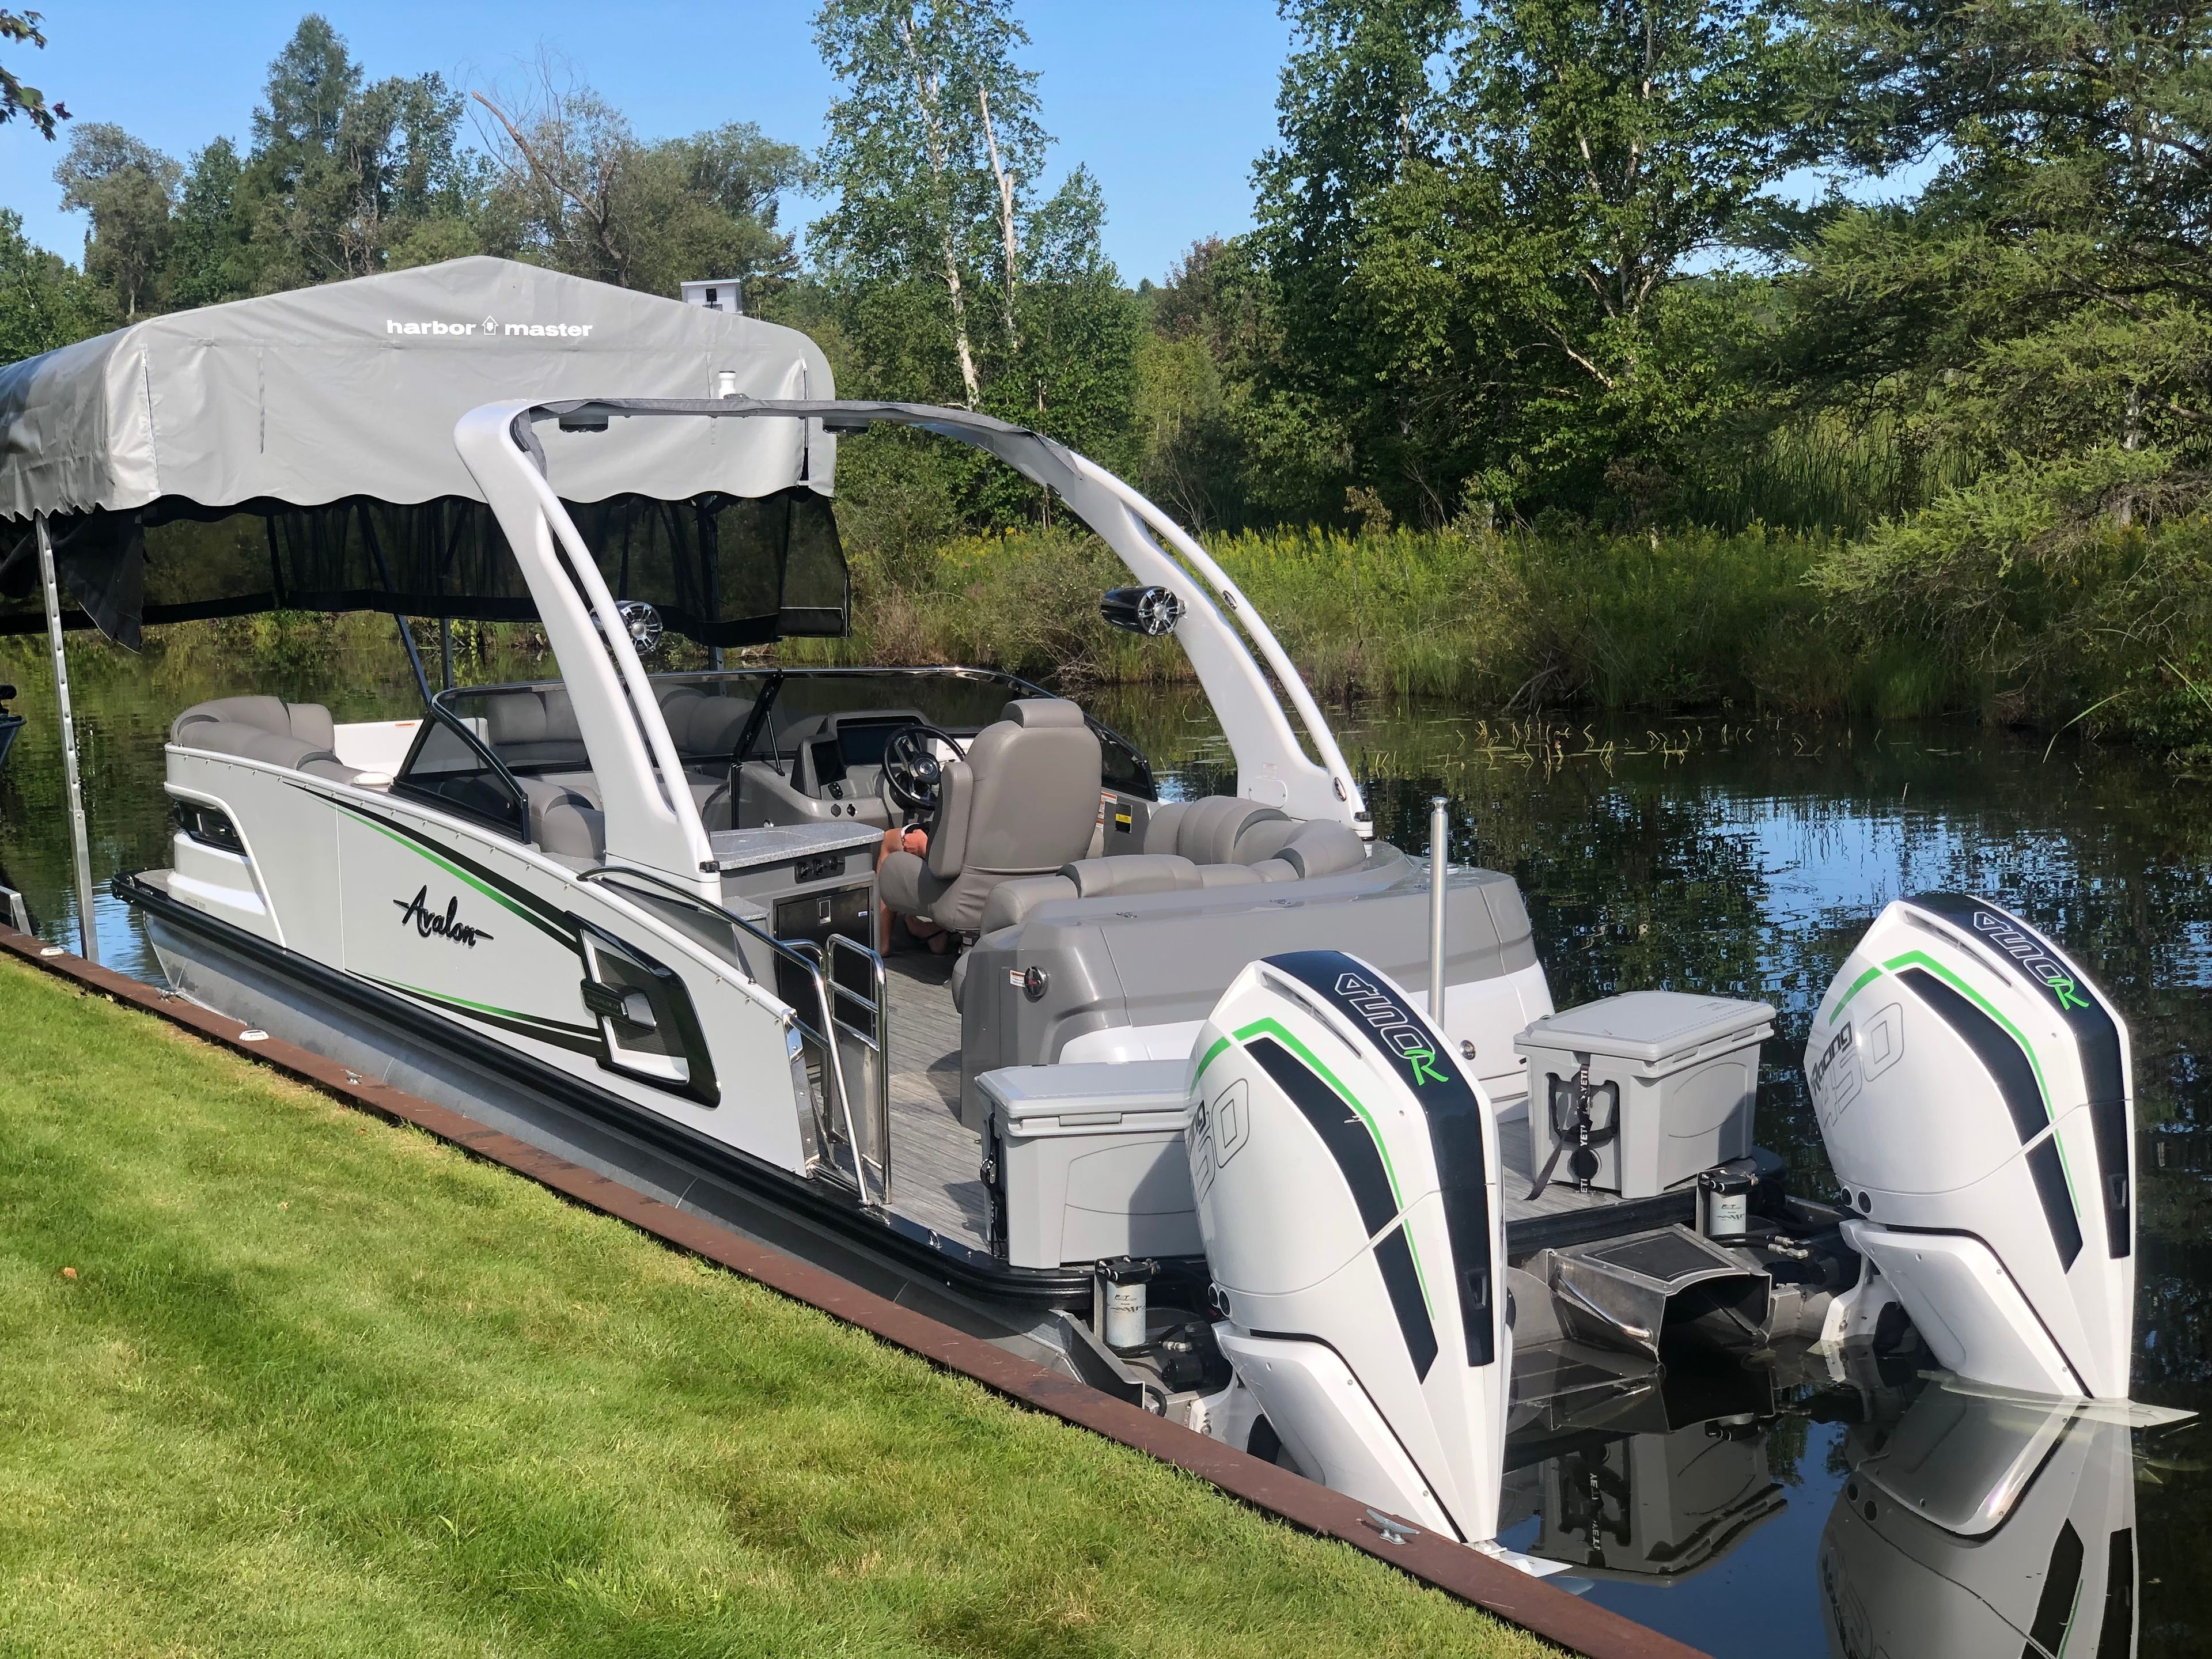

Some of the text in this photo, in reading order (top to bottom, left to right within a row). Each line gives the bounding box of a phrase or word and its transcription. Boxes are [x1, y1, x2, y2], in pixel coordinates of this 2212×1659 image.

[387, 320, 593, 337] harbor master
[393, 884, 494, 946] Avalon
[1810, 1021, 1853, 1096] Racing
[1580, 1070, 1588, 1092] YETI
[1580, 1178, 1588, 1193] ETI
